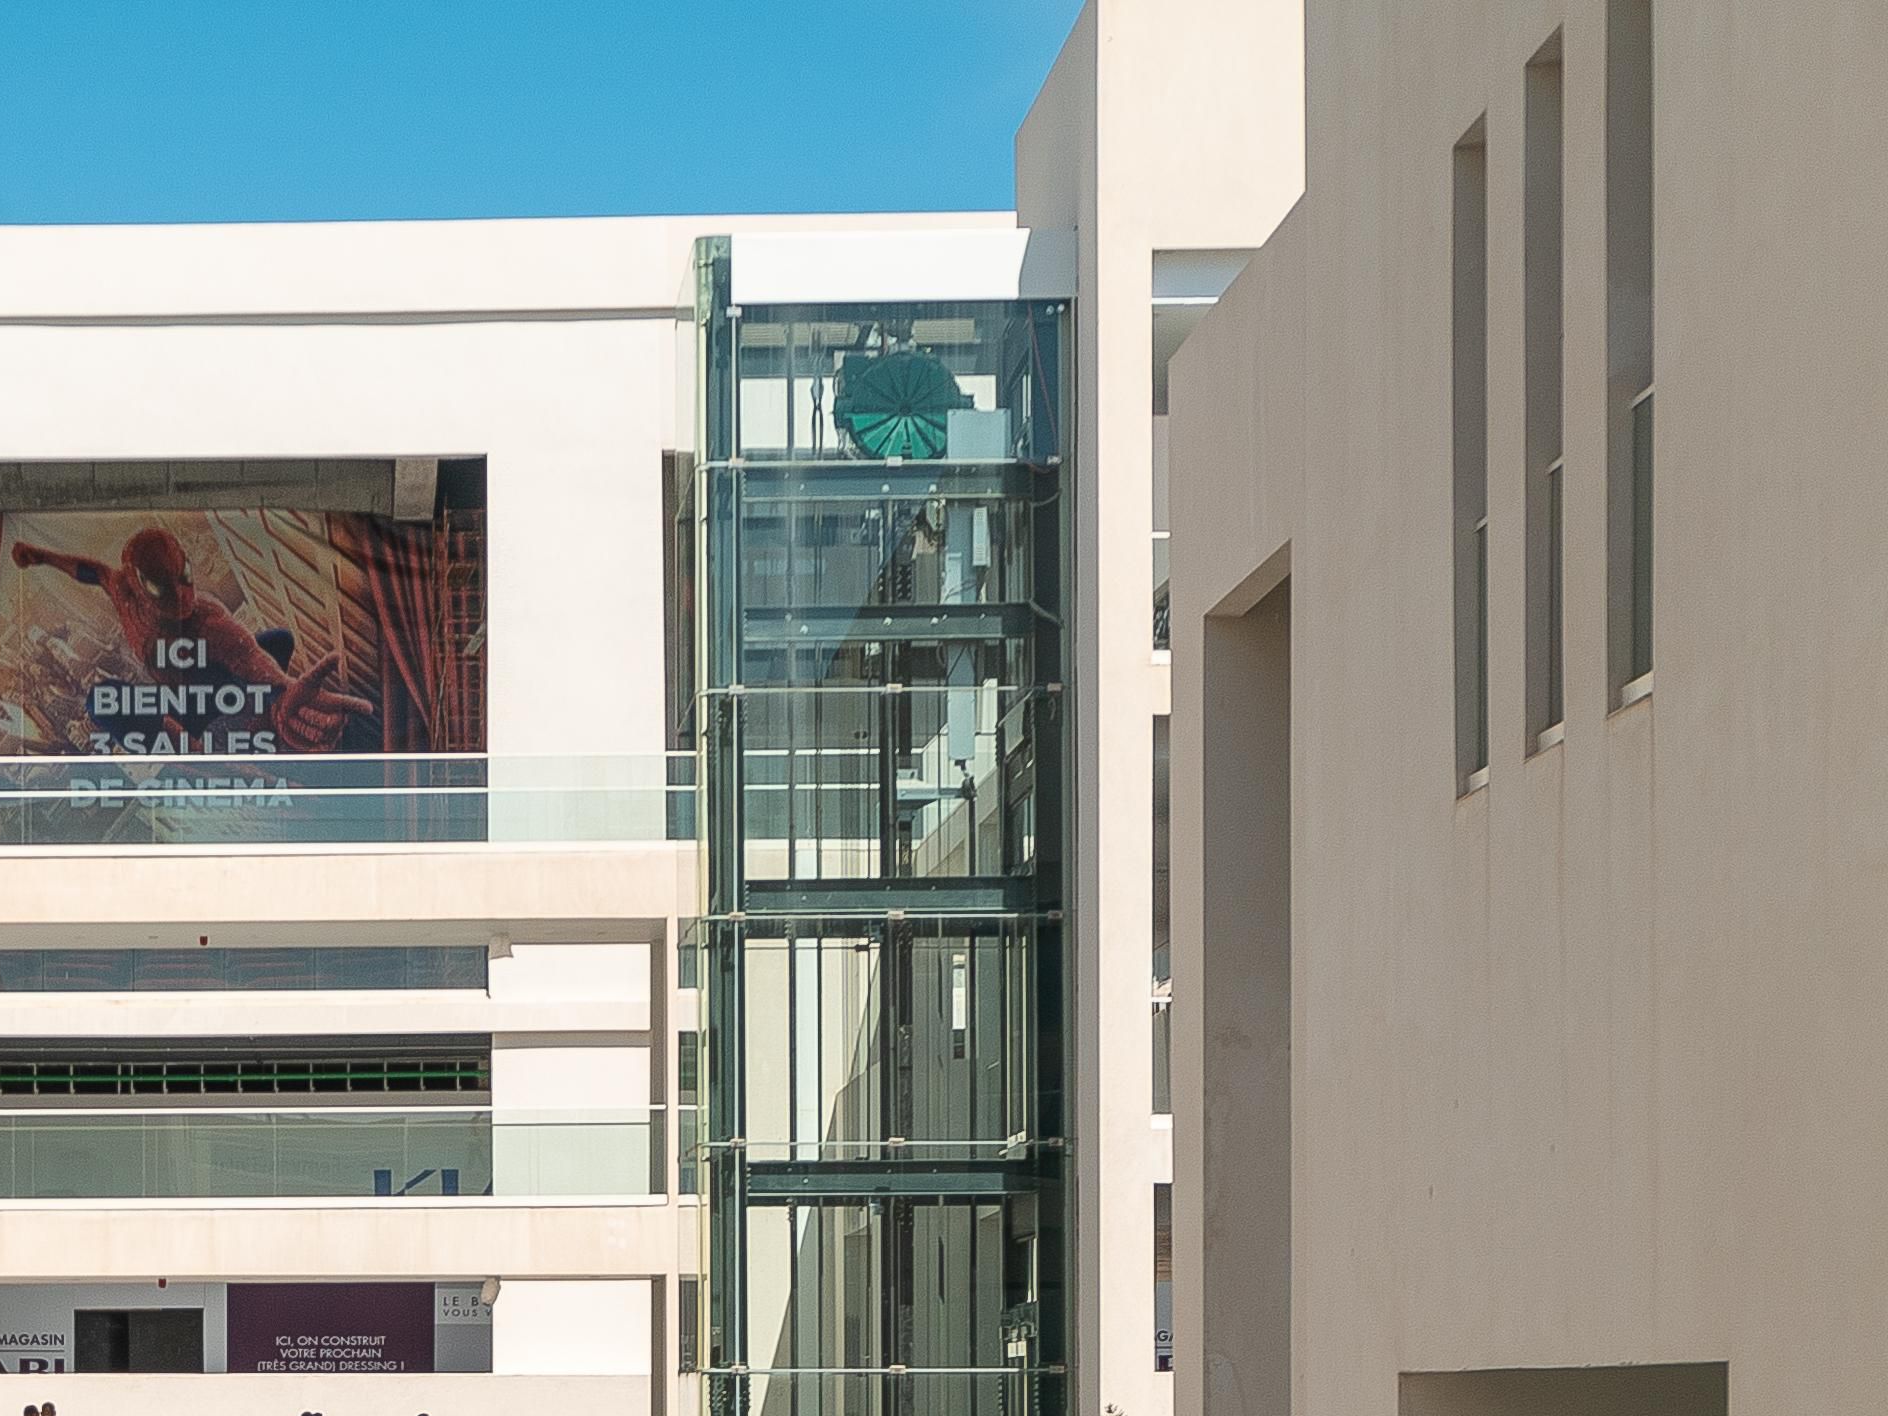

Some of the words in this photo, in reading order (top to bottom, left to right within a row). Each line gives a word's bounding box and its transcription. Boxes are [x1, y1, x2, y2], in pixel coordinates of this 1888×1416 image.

[157, 638, 207, 669] ICI
[93, 685, 272, 716] BIENTOT
[70, 778, 124, 808] DE
[137, 778, 294, 808] CINEMA
[443, 1308, 478, 1317] VOUS
[297, 1335, 319, 1346] ON
[321, 1335, 386, 1346] CONSTRUIT
[280, 1348, 317, 1359] VOTRE
[319, 1348, 382, 1359] PROCHAIN
[339, 1360, 398, 1371] DRESSING
